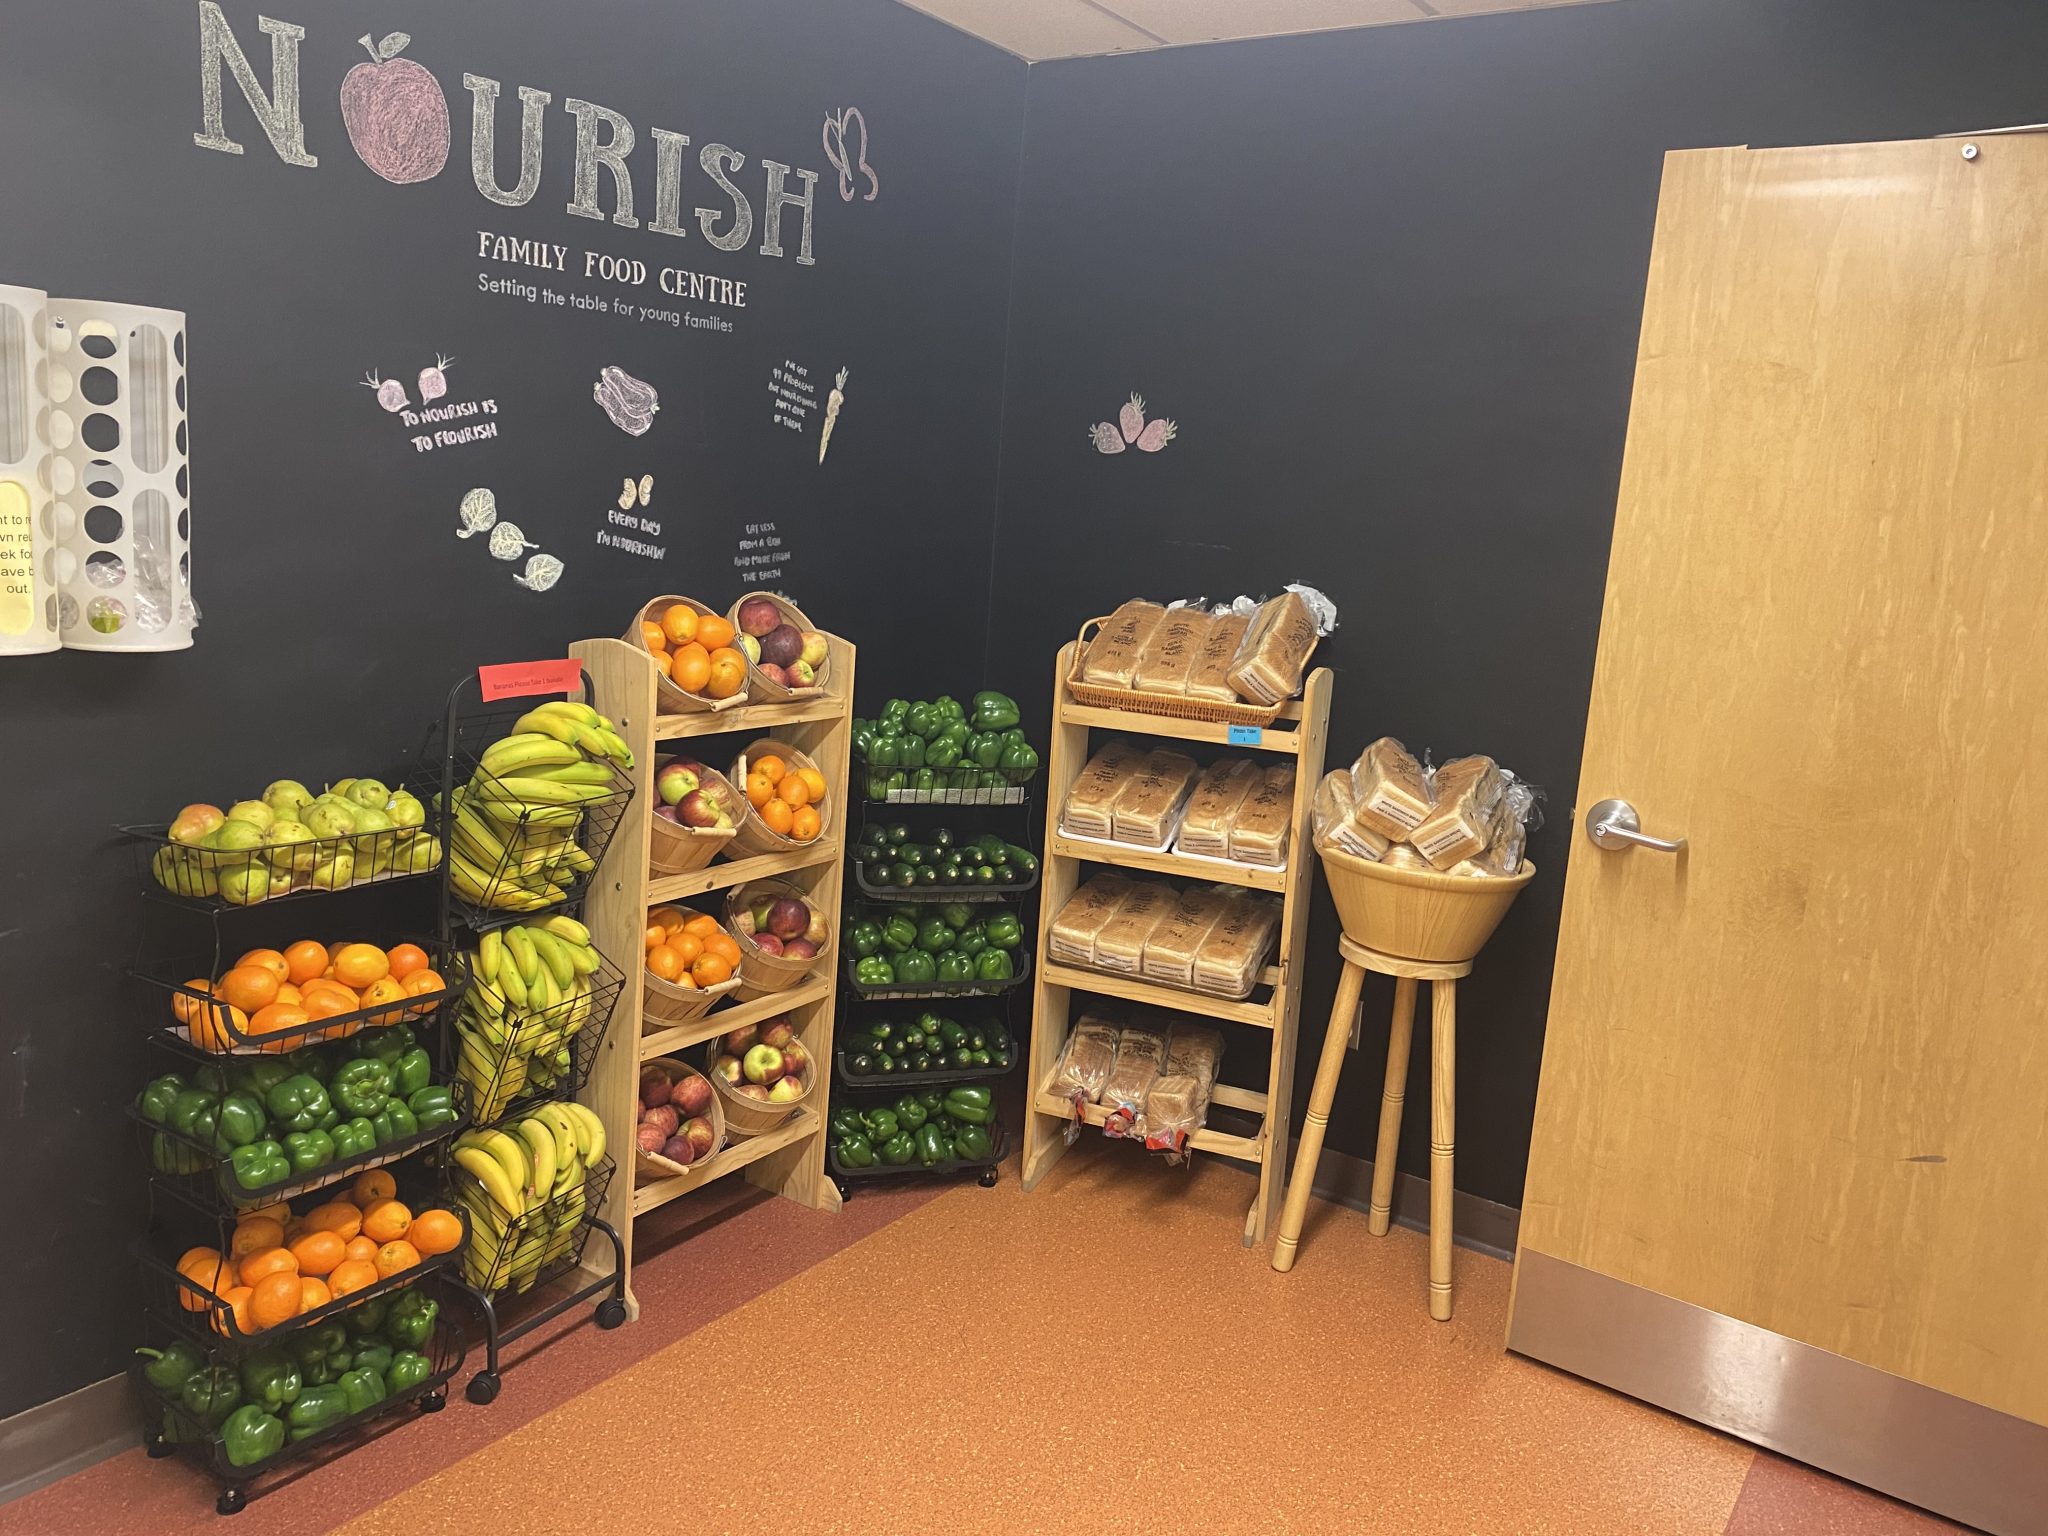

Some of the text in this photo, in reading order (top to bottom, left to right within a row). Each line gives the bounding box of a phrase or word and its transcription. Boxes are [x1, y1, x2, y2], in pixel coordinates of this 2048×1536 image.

[478, 231, 747, 307] FAMILY FOOD CENTRE
[478, 273, 733, 333] Setting the table for young families
[399, 399, 498, 427] TO NOURISH IS
[410, 421, 498, 453] TO FLOURISH
[12, 515, 23, 525] to
[607, 509, 661, 536] EVERY DAY
[6, 583, 31, 594] out.
